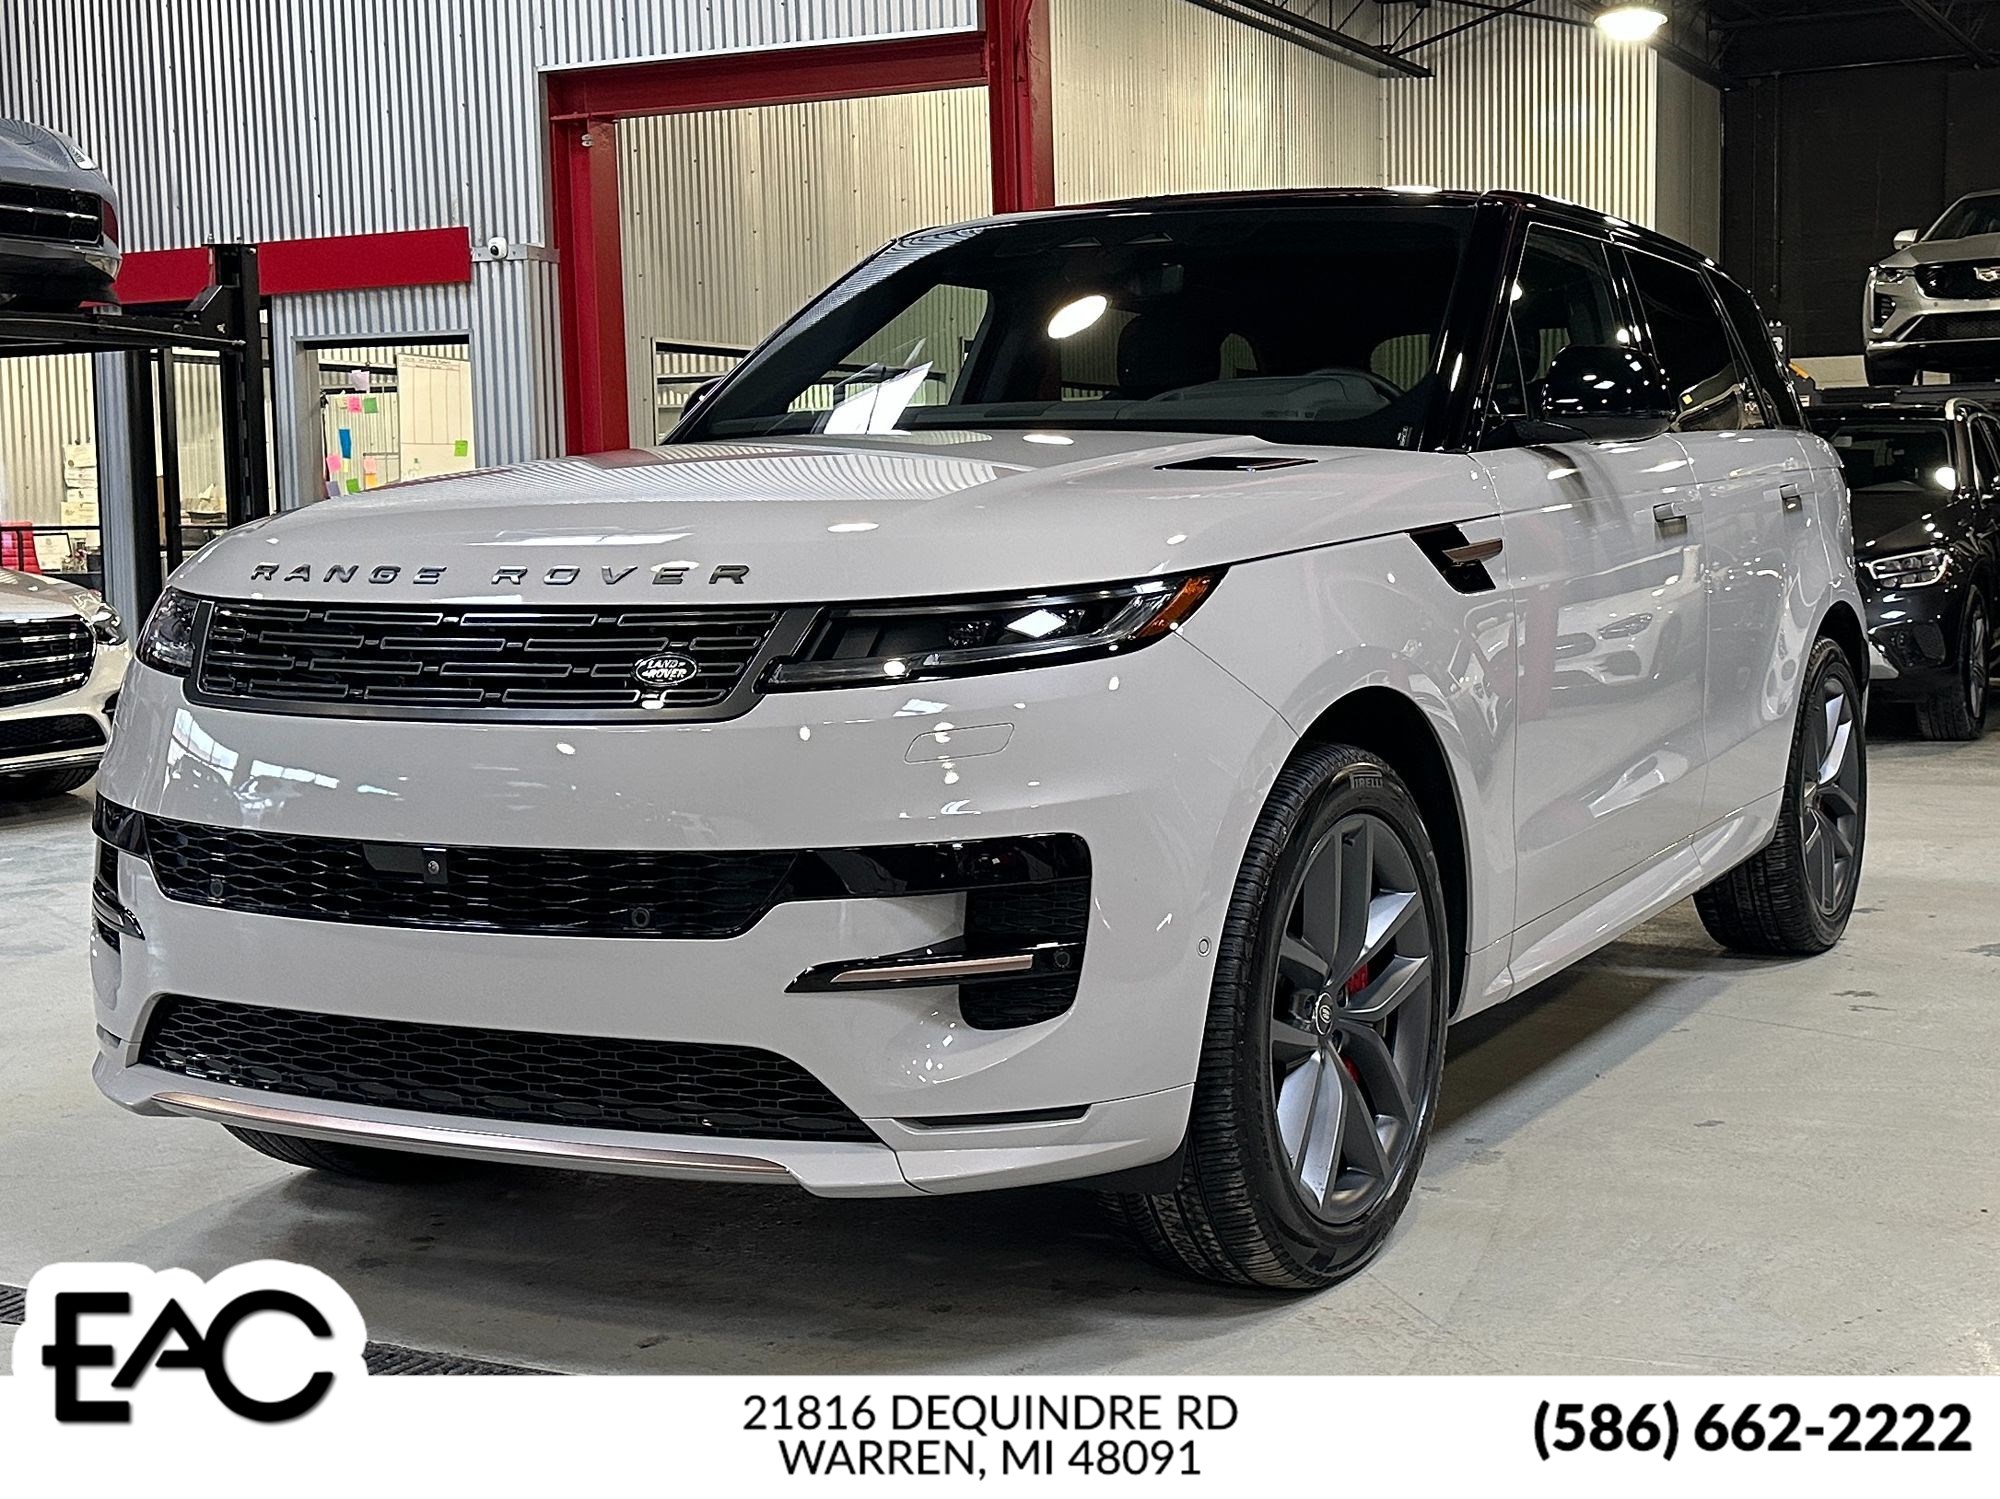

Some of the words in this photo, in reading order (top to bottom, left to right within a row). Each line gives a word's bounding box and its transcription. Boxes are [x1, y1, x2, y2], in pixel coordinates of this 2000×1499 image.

[250, 562, 448, 585] RANGE
[491, 564, 750, 586] ROVER
[1349, 770, 1384, 789] PIRELLI
